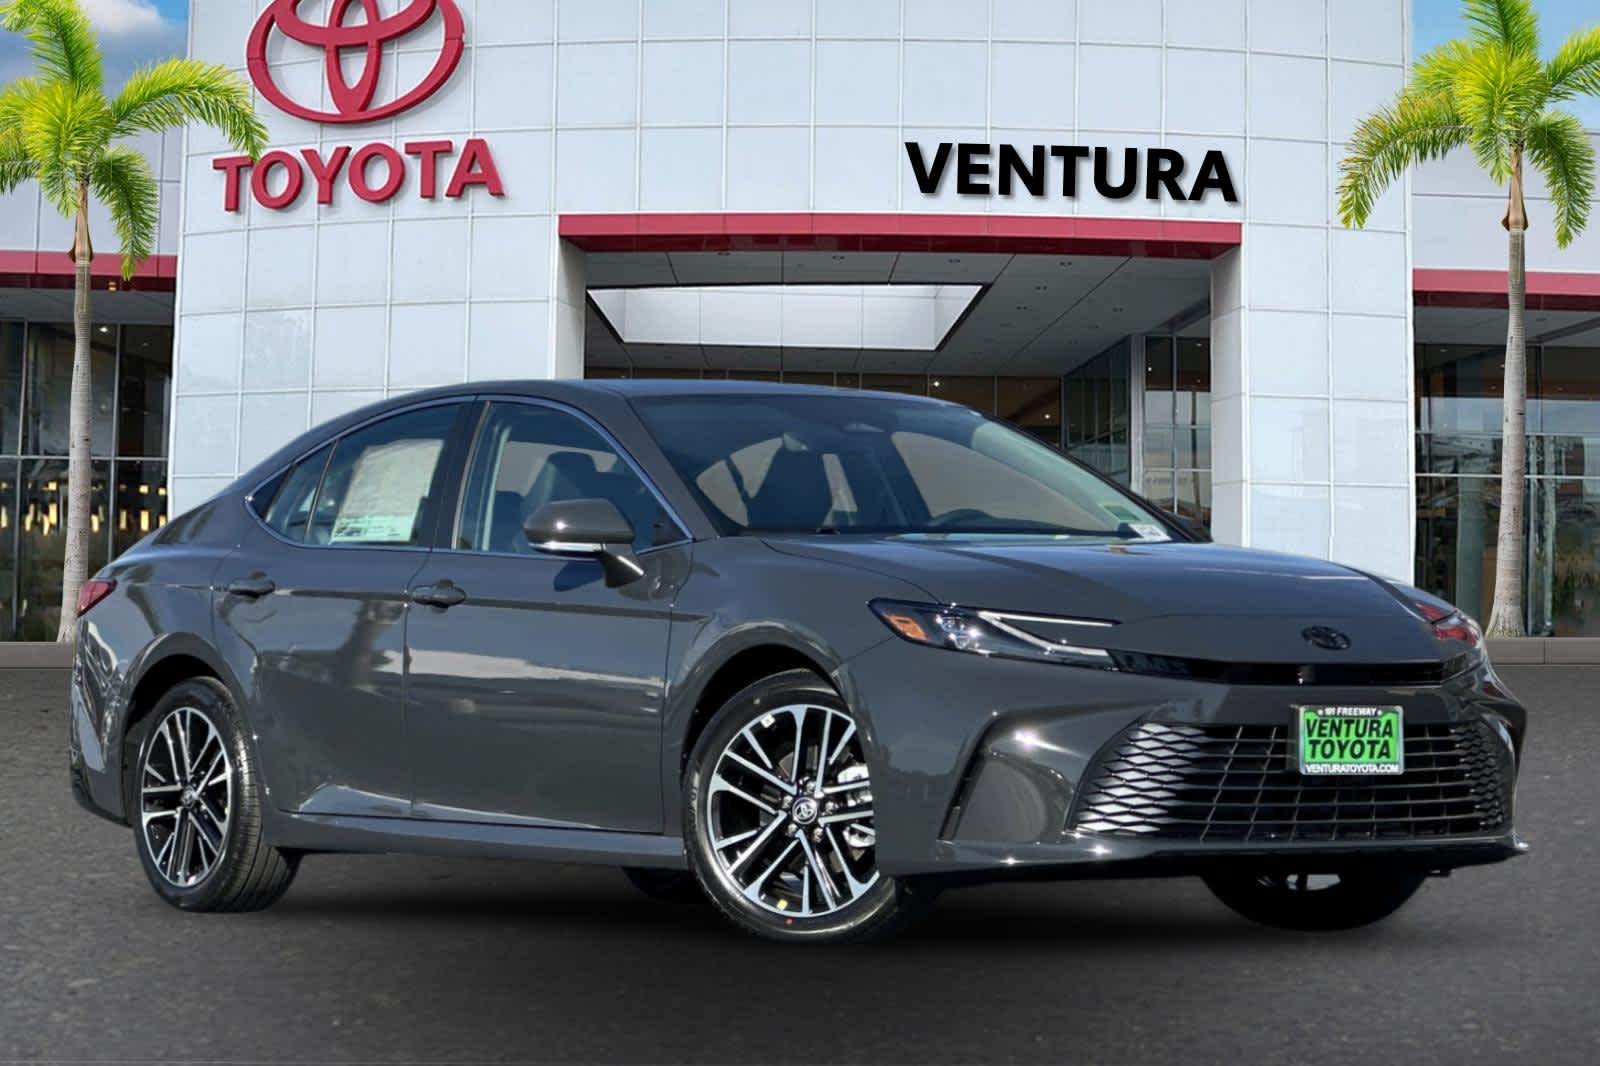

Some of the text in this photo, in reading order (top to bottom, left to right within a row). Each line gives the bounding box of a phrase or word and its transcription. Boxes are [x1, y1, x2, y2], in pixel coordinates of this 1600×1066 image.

[213, 138, 505, 212] TOYOTA
[904, 141, 1239, 203] VENTURA
[1336, 707, 1377, 716] FREEWAY
[1306, 719, 1393, 738] VENTURA
[1309, 739, 1391, 759] TOYOTA
[1305, 764, 1399, 773] VENTURATOYOTA.COM
